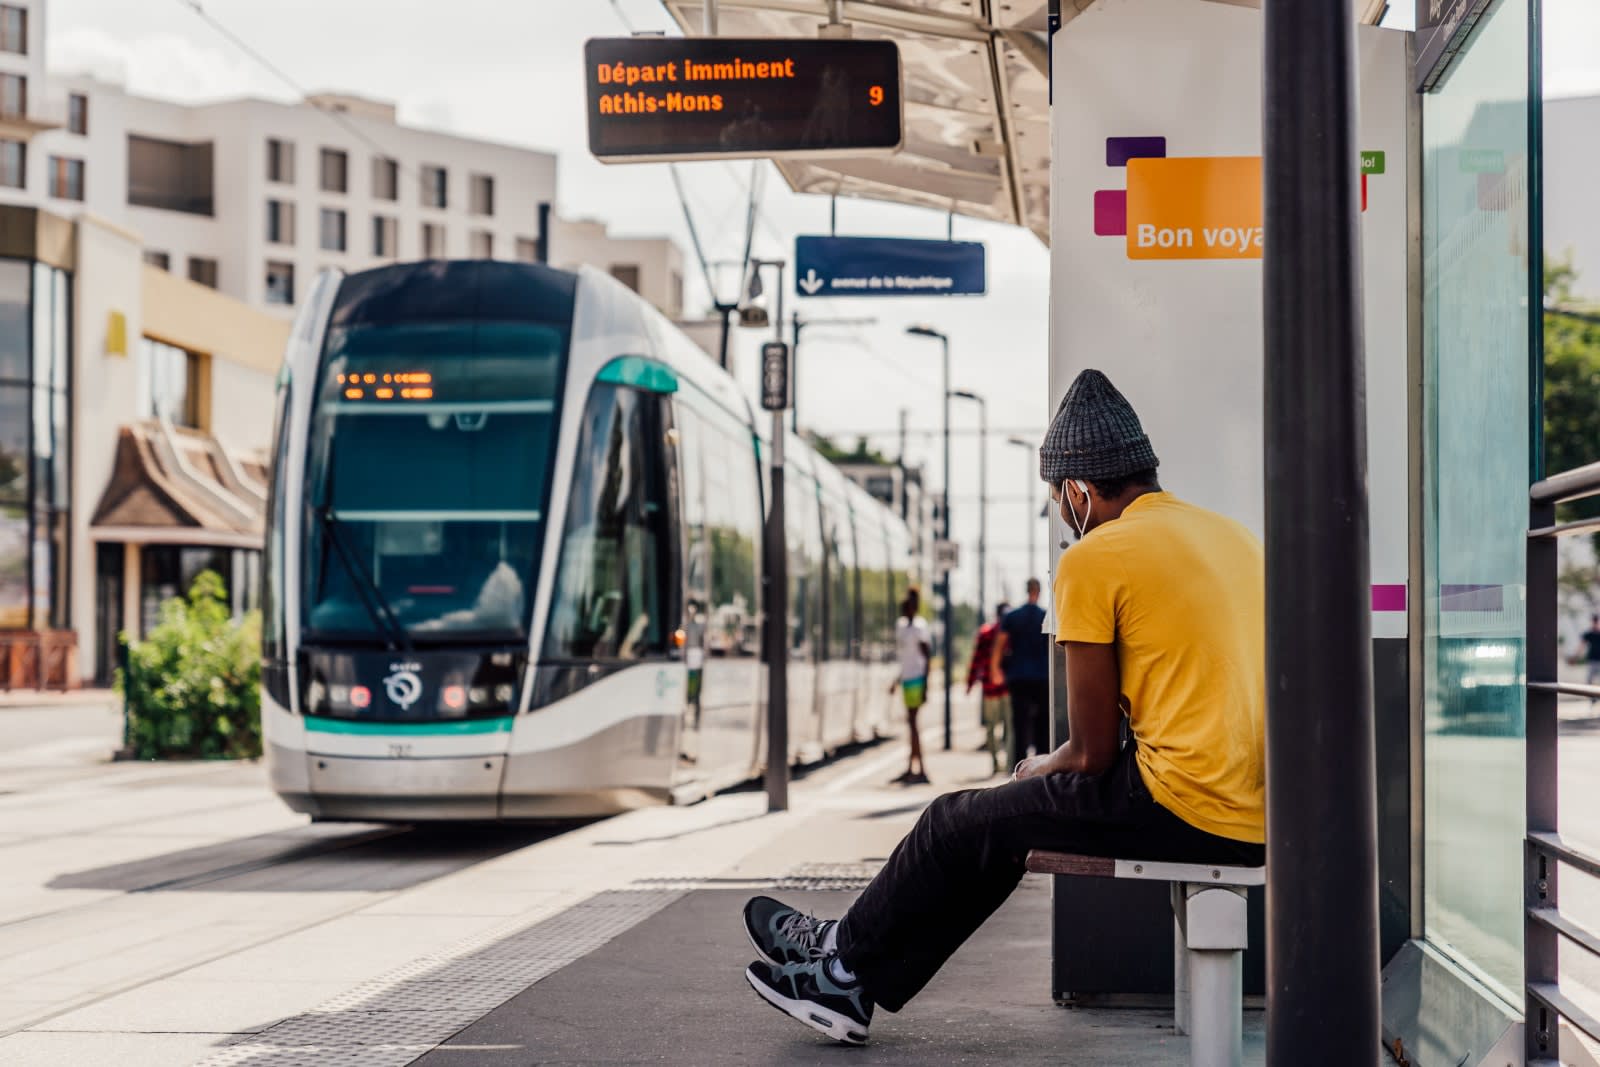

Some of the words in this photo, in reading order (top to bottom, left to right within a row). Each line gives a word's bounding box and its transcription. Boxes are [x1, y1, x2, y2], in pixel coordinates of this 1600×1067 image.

[598, 61, 677, 86] Départ
[684, 58, 794, 81] imminent
[600, 91, 723, 114] Athis-Mons
[869, 85, 883, 106] 9
[1361, 156, 1375, 168] lo!
[1137, 223, 1193, 248] Bon
[1203, 227, 1264, 253] voya
